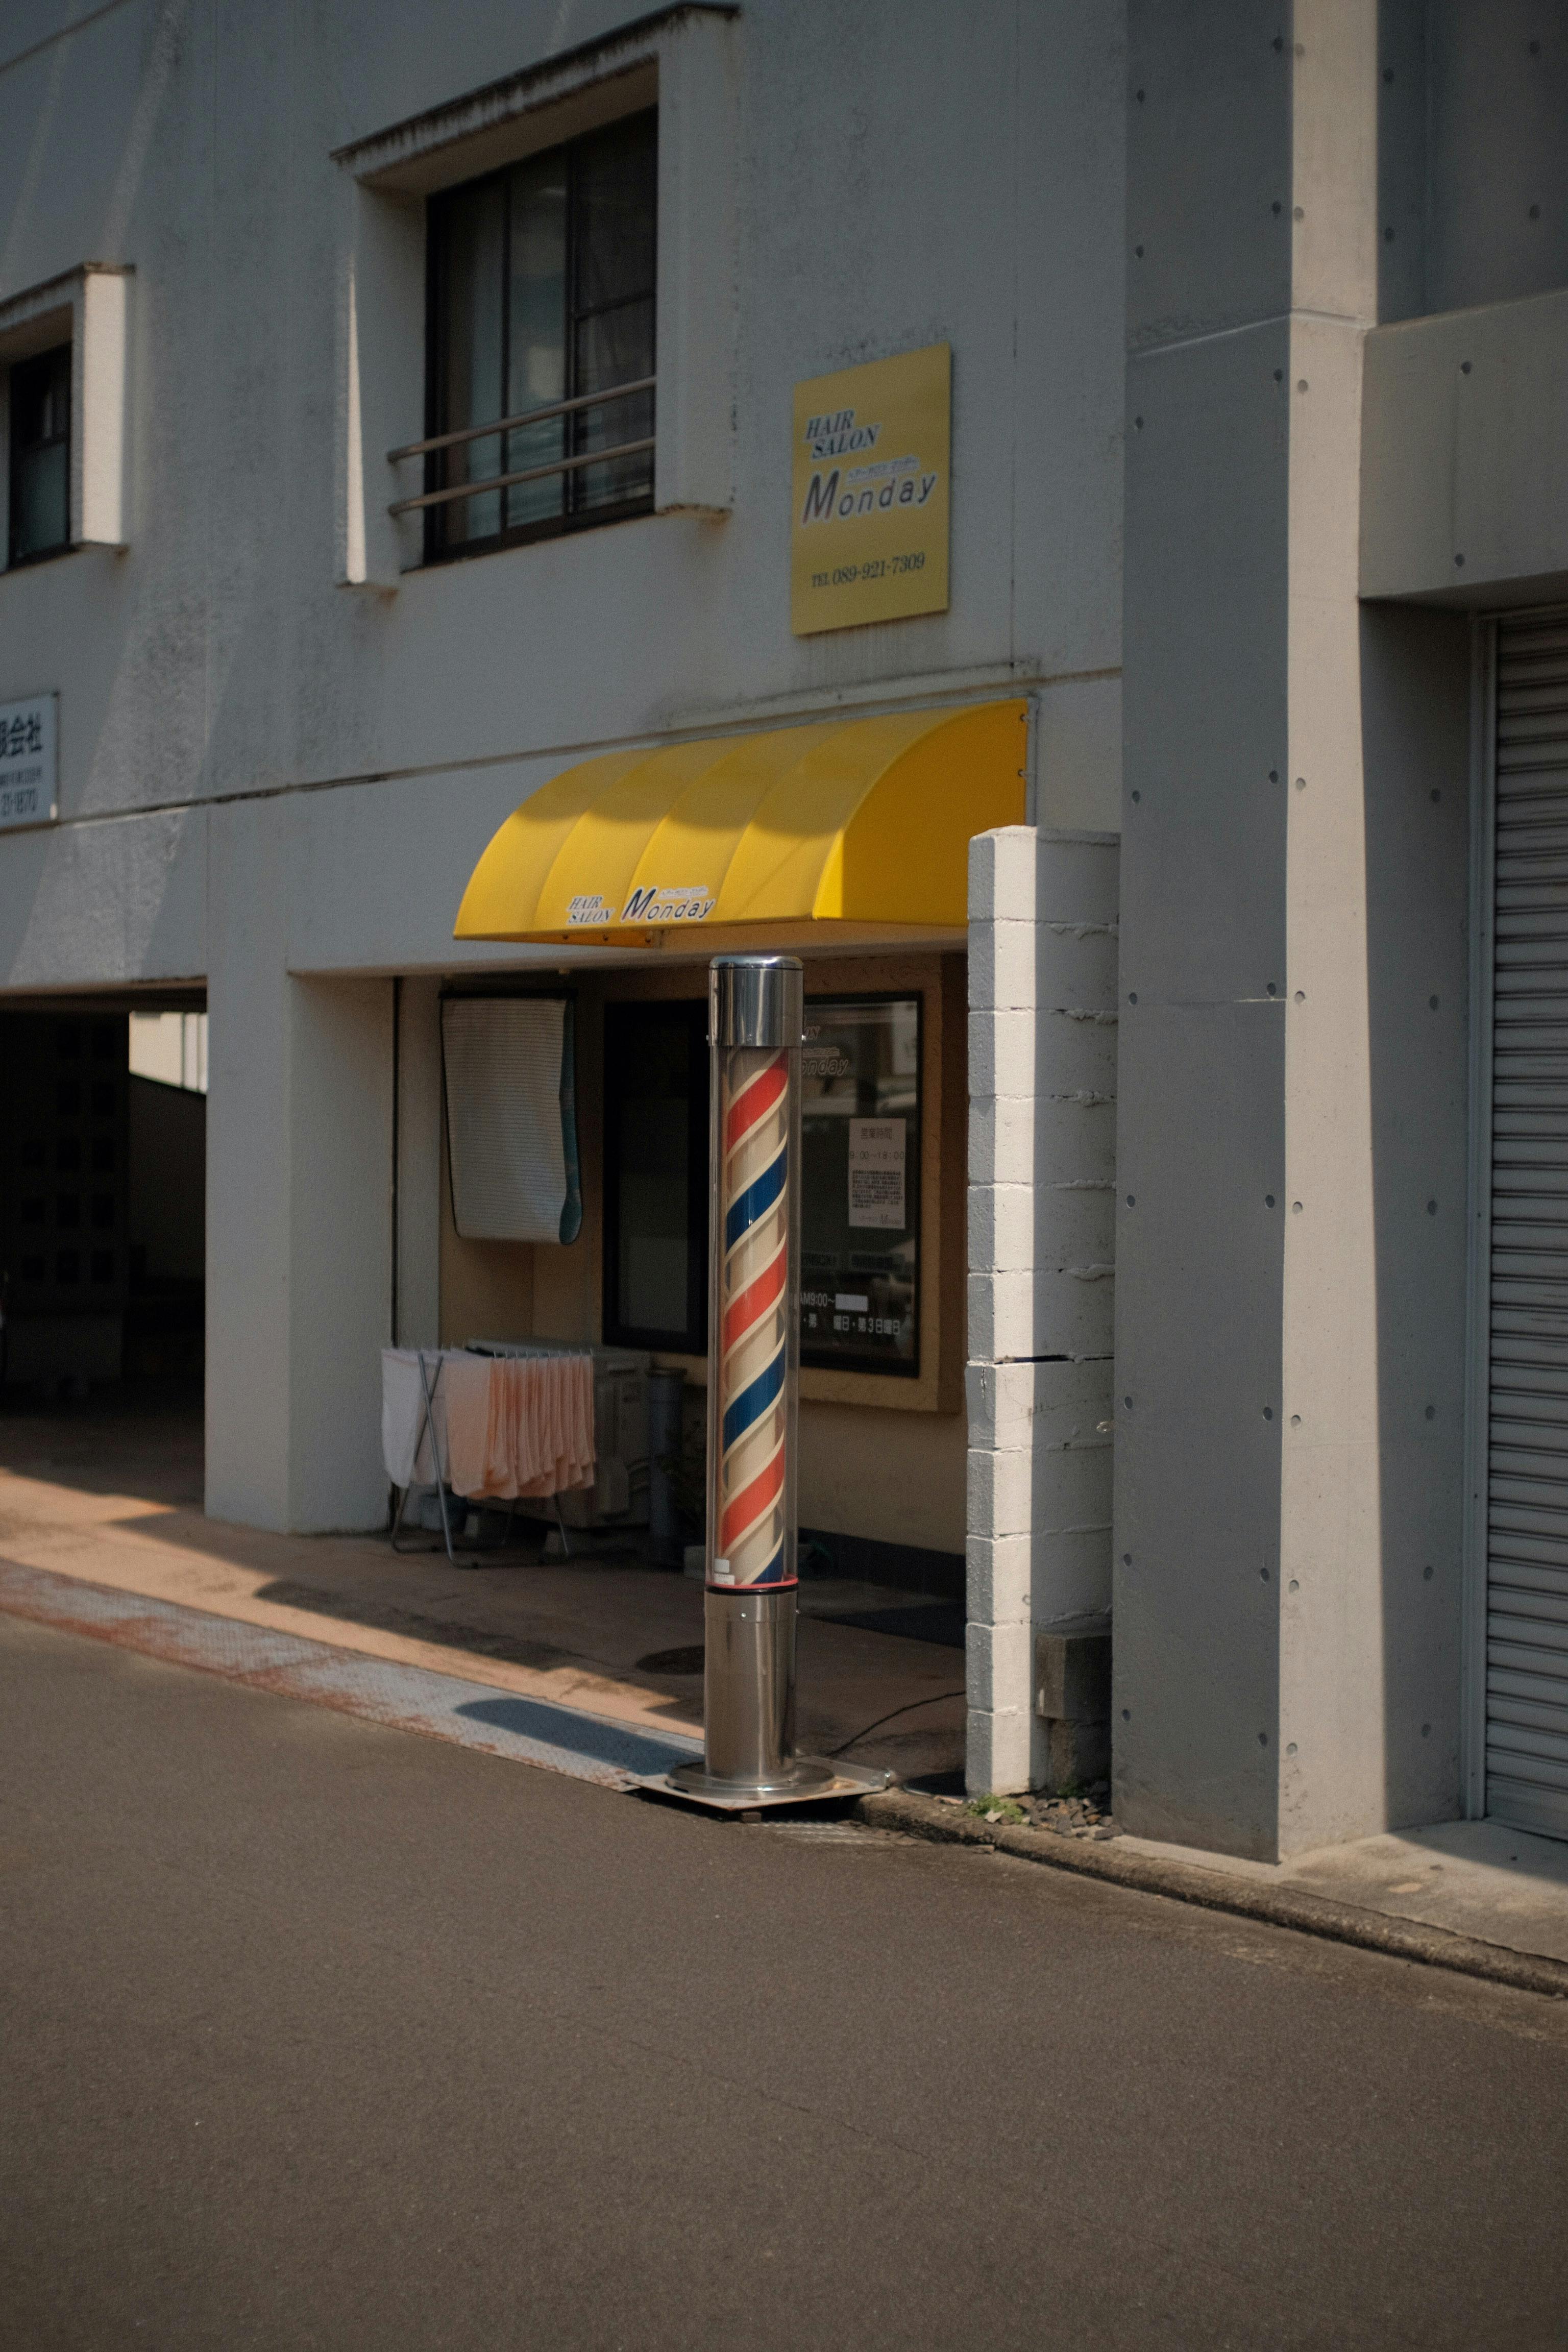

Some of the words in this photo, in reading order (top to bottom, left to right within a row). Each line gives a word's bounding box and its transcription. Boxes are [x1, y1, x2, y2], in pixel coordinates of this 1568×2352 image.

[806, 409, 854, 439] HAIR
[812, 424, 879, 459] SALON
[802, 470, 936, 524] Monday
[832, 552, 925, 585] 089-921-7309
[568, 909, 613, 923] SALON
[569, 896, 603, 910] HAIR
[621, 888, 715, 920] Monday
[802, 1056, 848, 1075] onday
[861, 1126, 892, 1140] 営業時間
